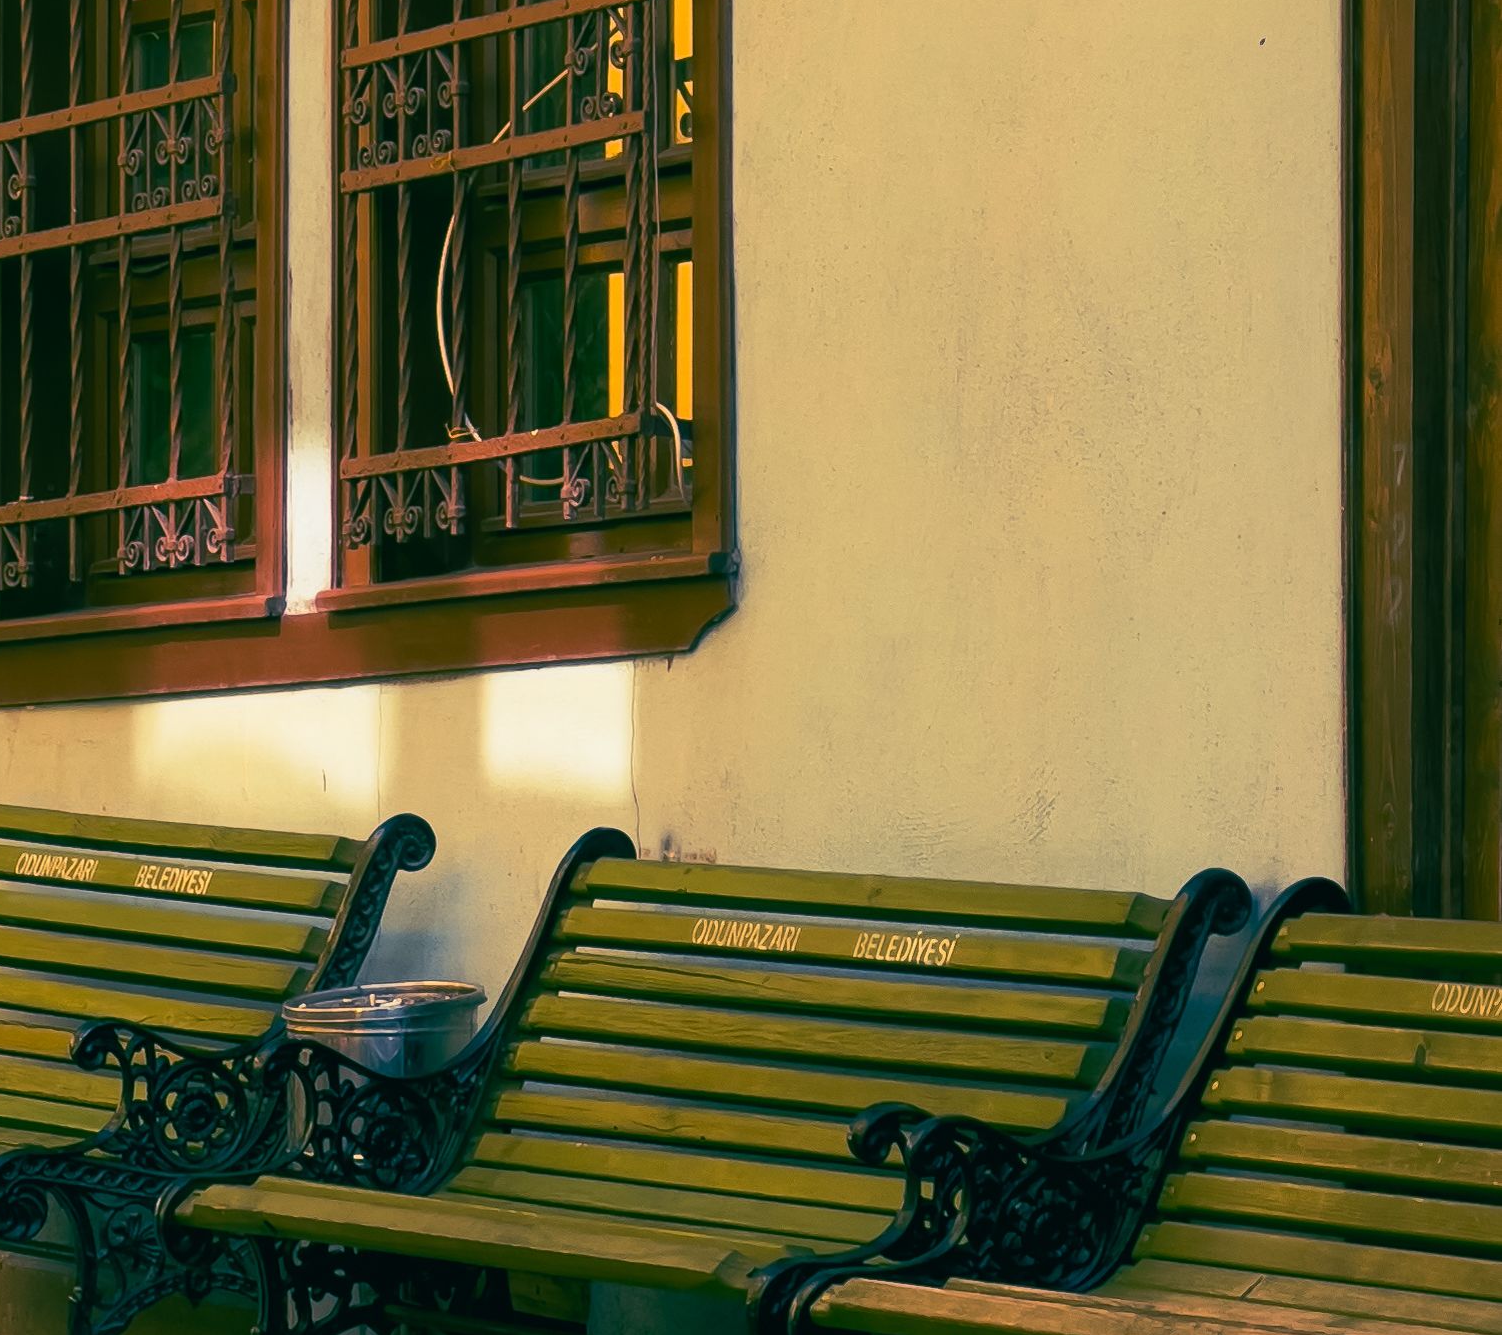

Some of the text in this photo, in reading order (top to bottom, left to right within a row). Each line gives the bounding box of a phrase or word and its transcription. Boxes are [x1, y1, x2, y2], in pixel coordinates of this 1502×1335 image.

[14, 852, 100, 881] ODUNPAZARI
[691, 917, 961, 967] ODUNPAZARI BELEDİYESİ
